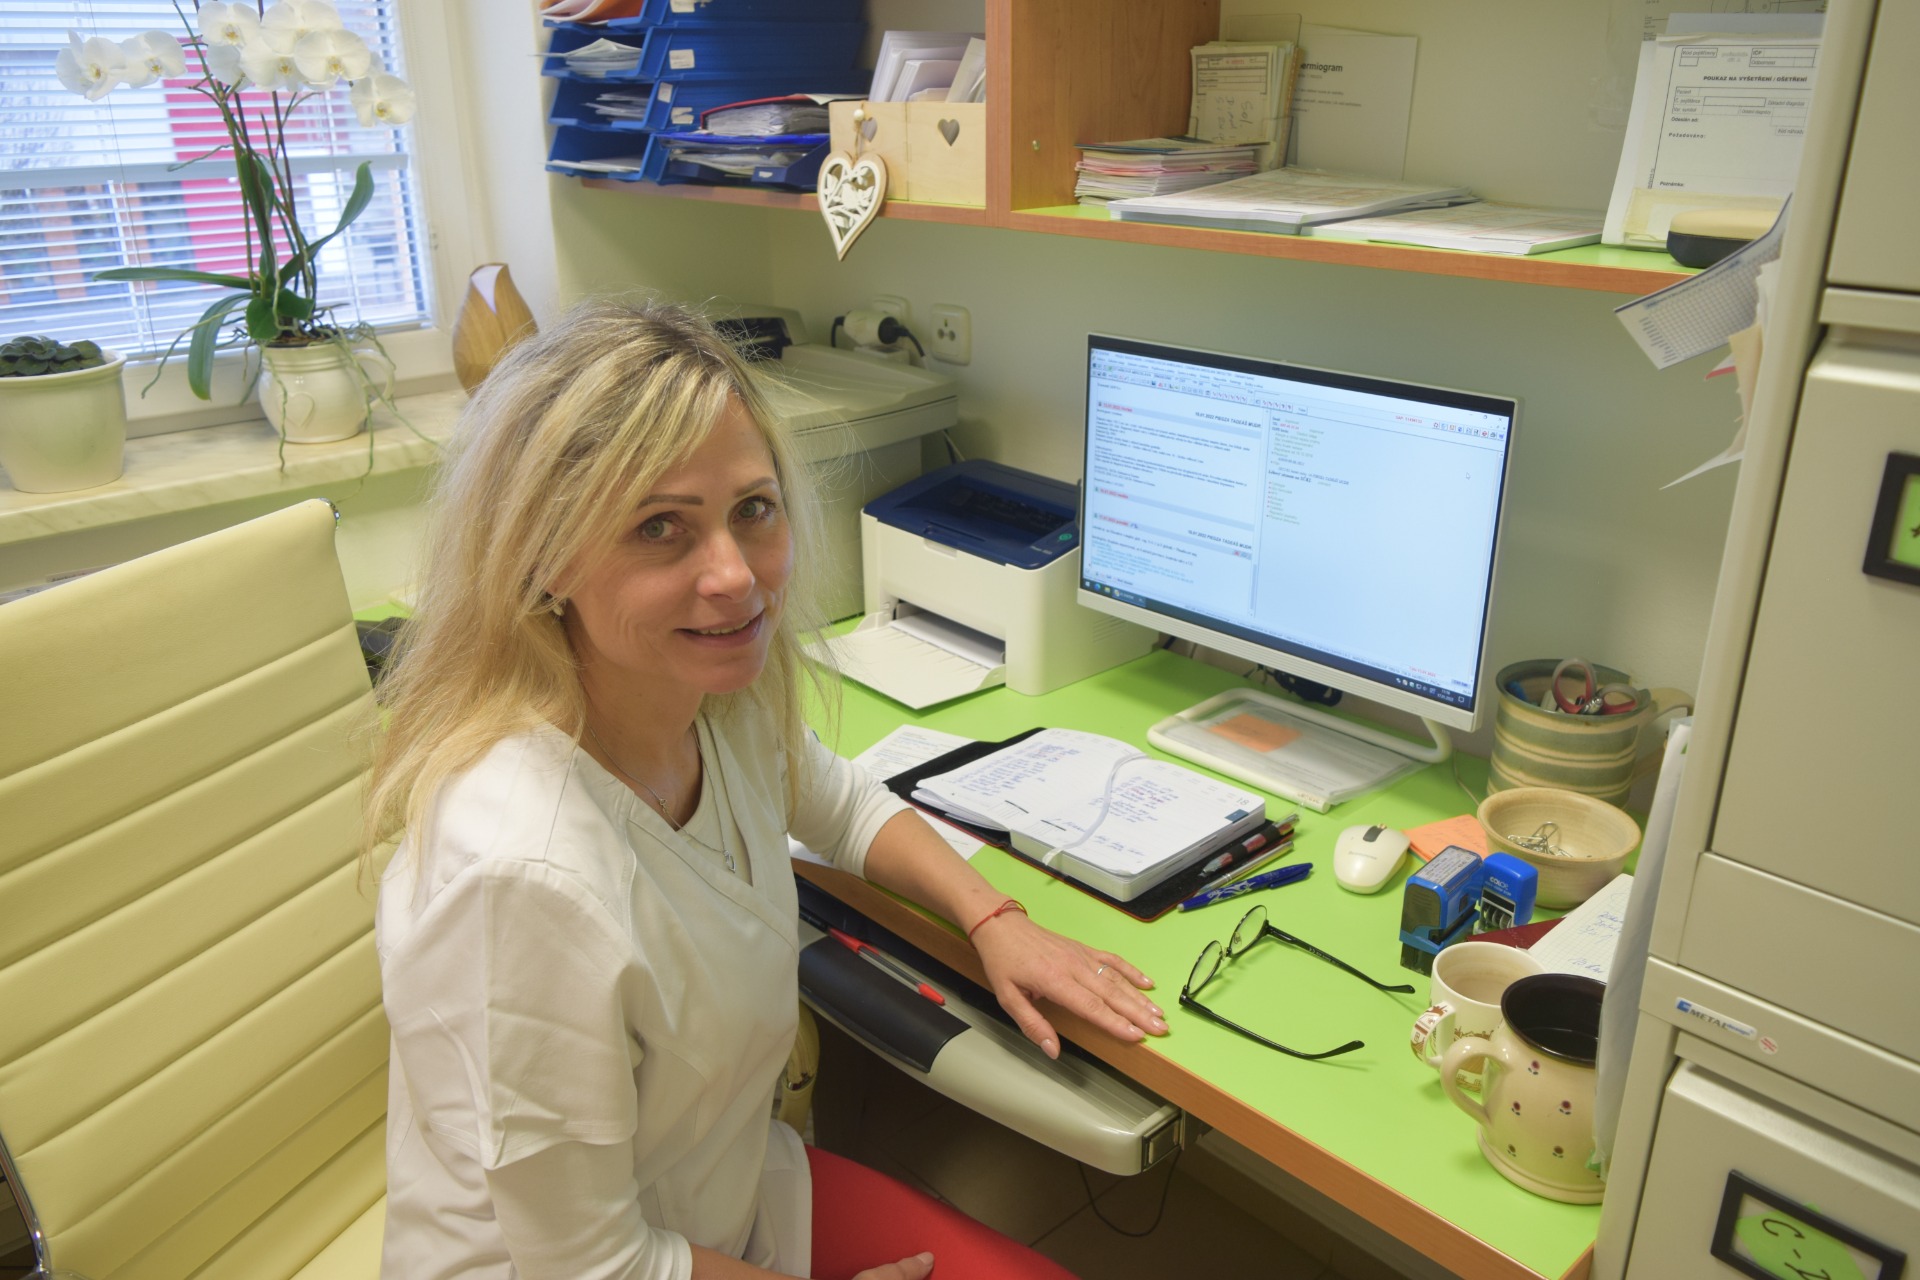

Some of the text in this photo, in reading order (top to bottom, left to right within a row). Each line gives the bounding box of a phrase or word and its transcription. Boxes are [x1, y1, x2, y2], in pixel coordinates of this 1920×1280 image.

[1300, 62, 1343, 74] ermiogram
[1738, 74, 1773, 82] VYŠETŘENÍ
[1776, 75, 1808, 83] OŠETŘENÍ
